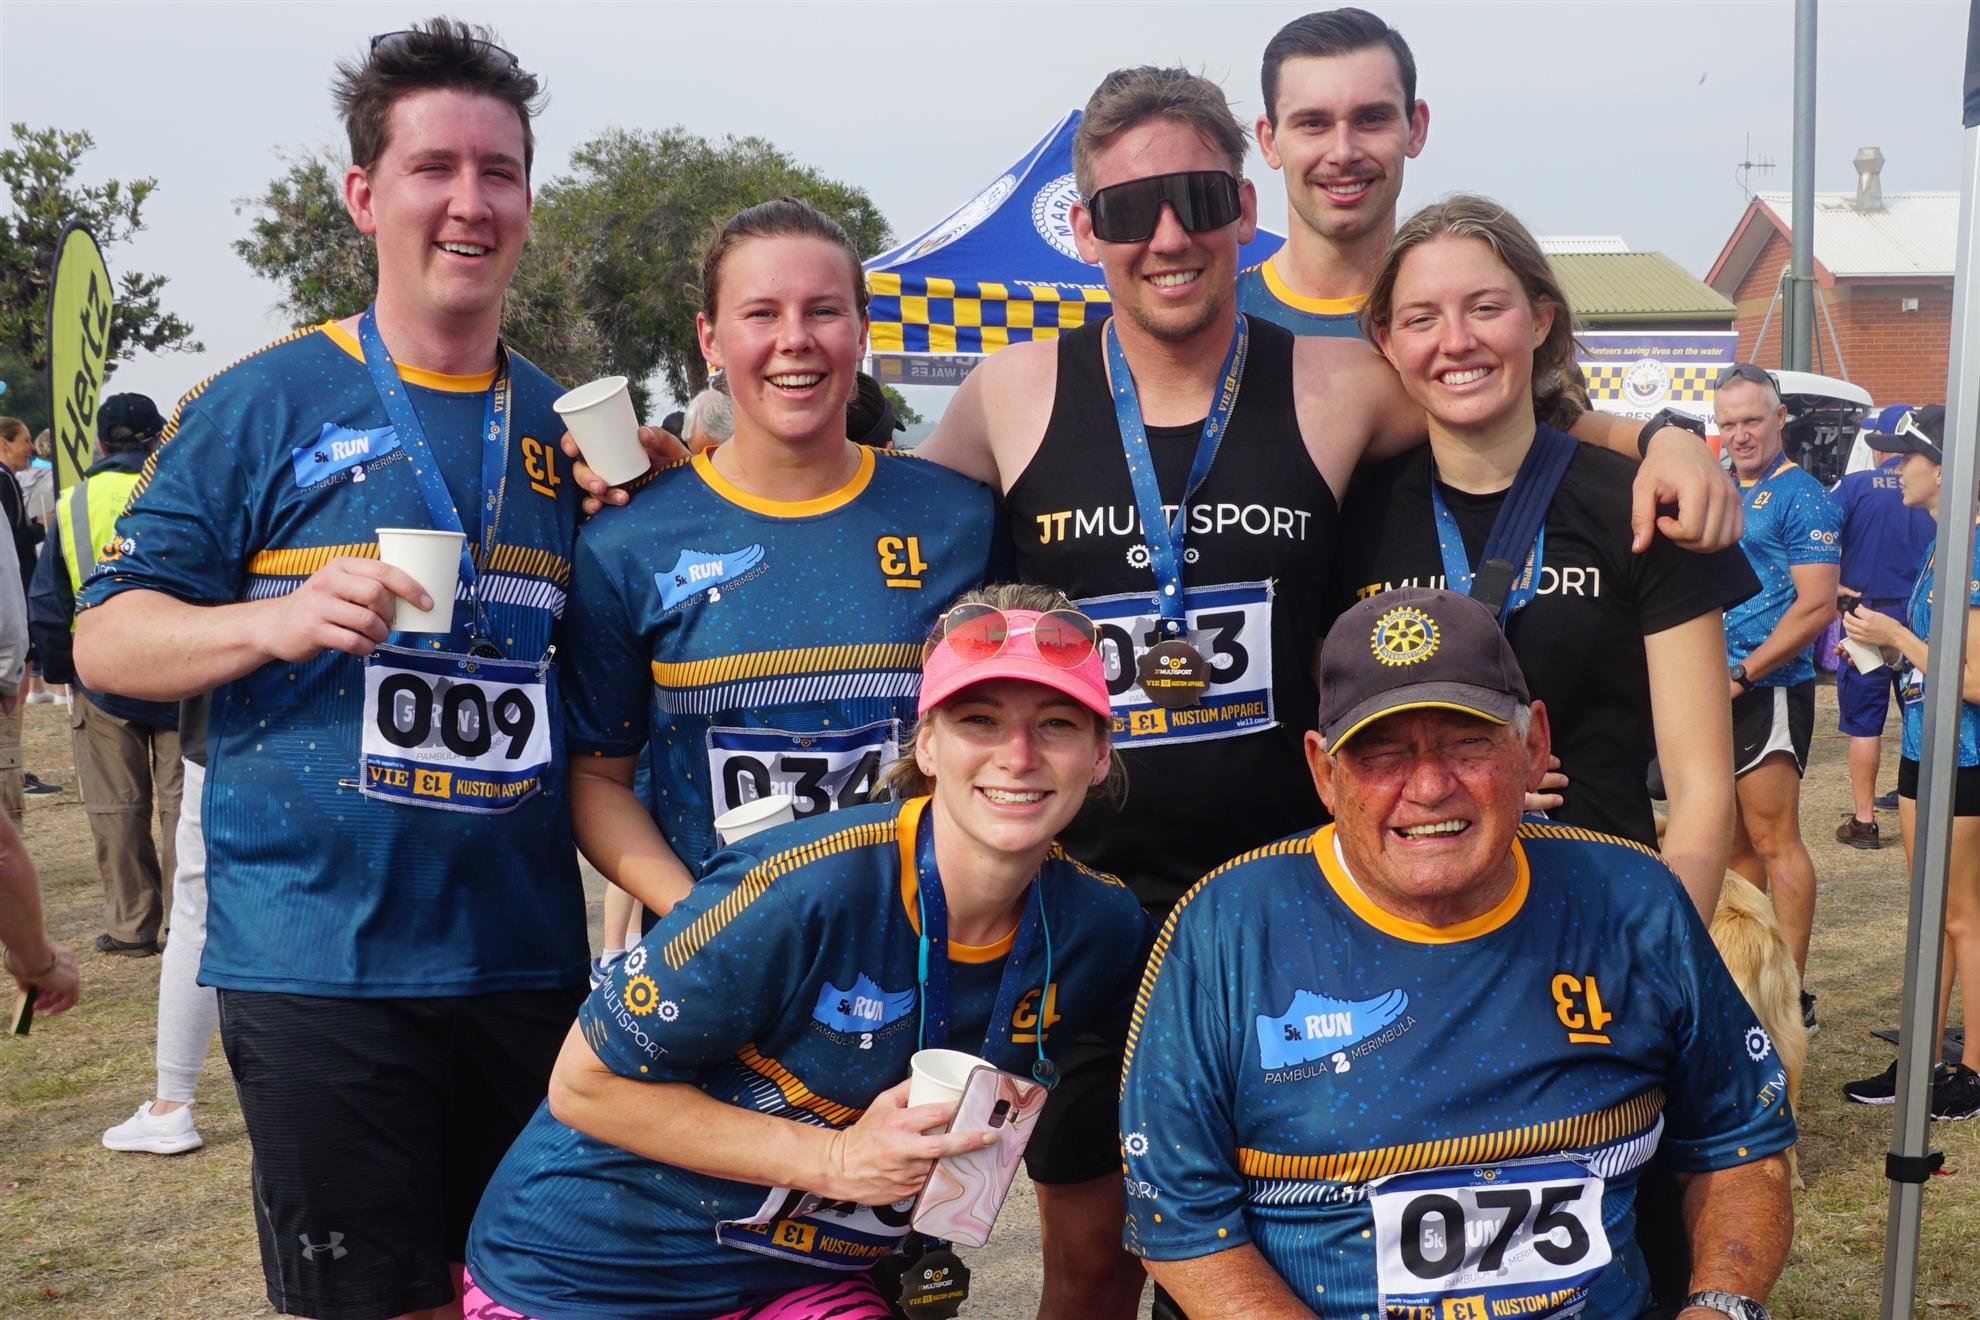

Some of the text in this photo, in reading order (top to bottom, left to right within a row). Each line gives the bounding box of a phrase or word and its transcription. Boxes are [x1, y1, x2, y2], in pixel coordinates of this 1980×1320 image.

[1051, 189, 1079, 237] MARIN
[1623, 347, 1650, 357] saving
[1652, 346, 1670, 355] lives
[1685, 346, 1698, 355] the
[1700, 347, 1724, 355] water
[61, 269, 108, 482] Hertz
[314, 436, 370, 464] 5k RUN
[351, 465, 366, 483] 2
[1036, 503, 1312, 545] JTMUTISPORT
[877, 536, 928, 576] 13
[675, 560, 724, 587] 5k RUN
[707, 587, 721, 603] 2
[721, 562, 771, 593] MERIMBULA
[1099, 611, 1249, 696] 03
[377, 673, 536, 760] 009
[1138, 714, 1158, 730] 13
[1172, 709, 1218, 726] KUSTOM
[1221, 701, 1265, 720] APPAREL
[368, 766, 410, 787] VIE
[422, 774, 442, 793] 13
[456, 778, 499, 797] KUSTOM
[837, 996, 884, 1021] 5k RUN
[1012, 983, 1061, 1029] 13
[1551, 973, 1612, 1031] 13
[809, 1020, 855, 1046] PAMBULA
[859, 1033, 873, 1049] 2
[1284, 1011, 1352, 1041] 5k RUN
[1264, 1015, 1417, 1085] PAMBULA 2 MERIMBULA
[784, 1224, 805, 1245] 13
[819, 1235, 867, 1257] KUSTOM
[1401, 1185, 1590, 1279] 075
[1424, 1228, 1444, 1248] 5k
[1465, 1219, 1501, 1247] UN
[1492, 1294, 1548, 1316] KUSTOM
